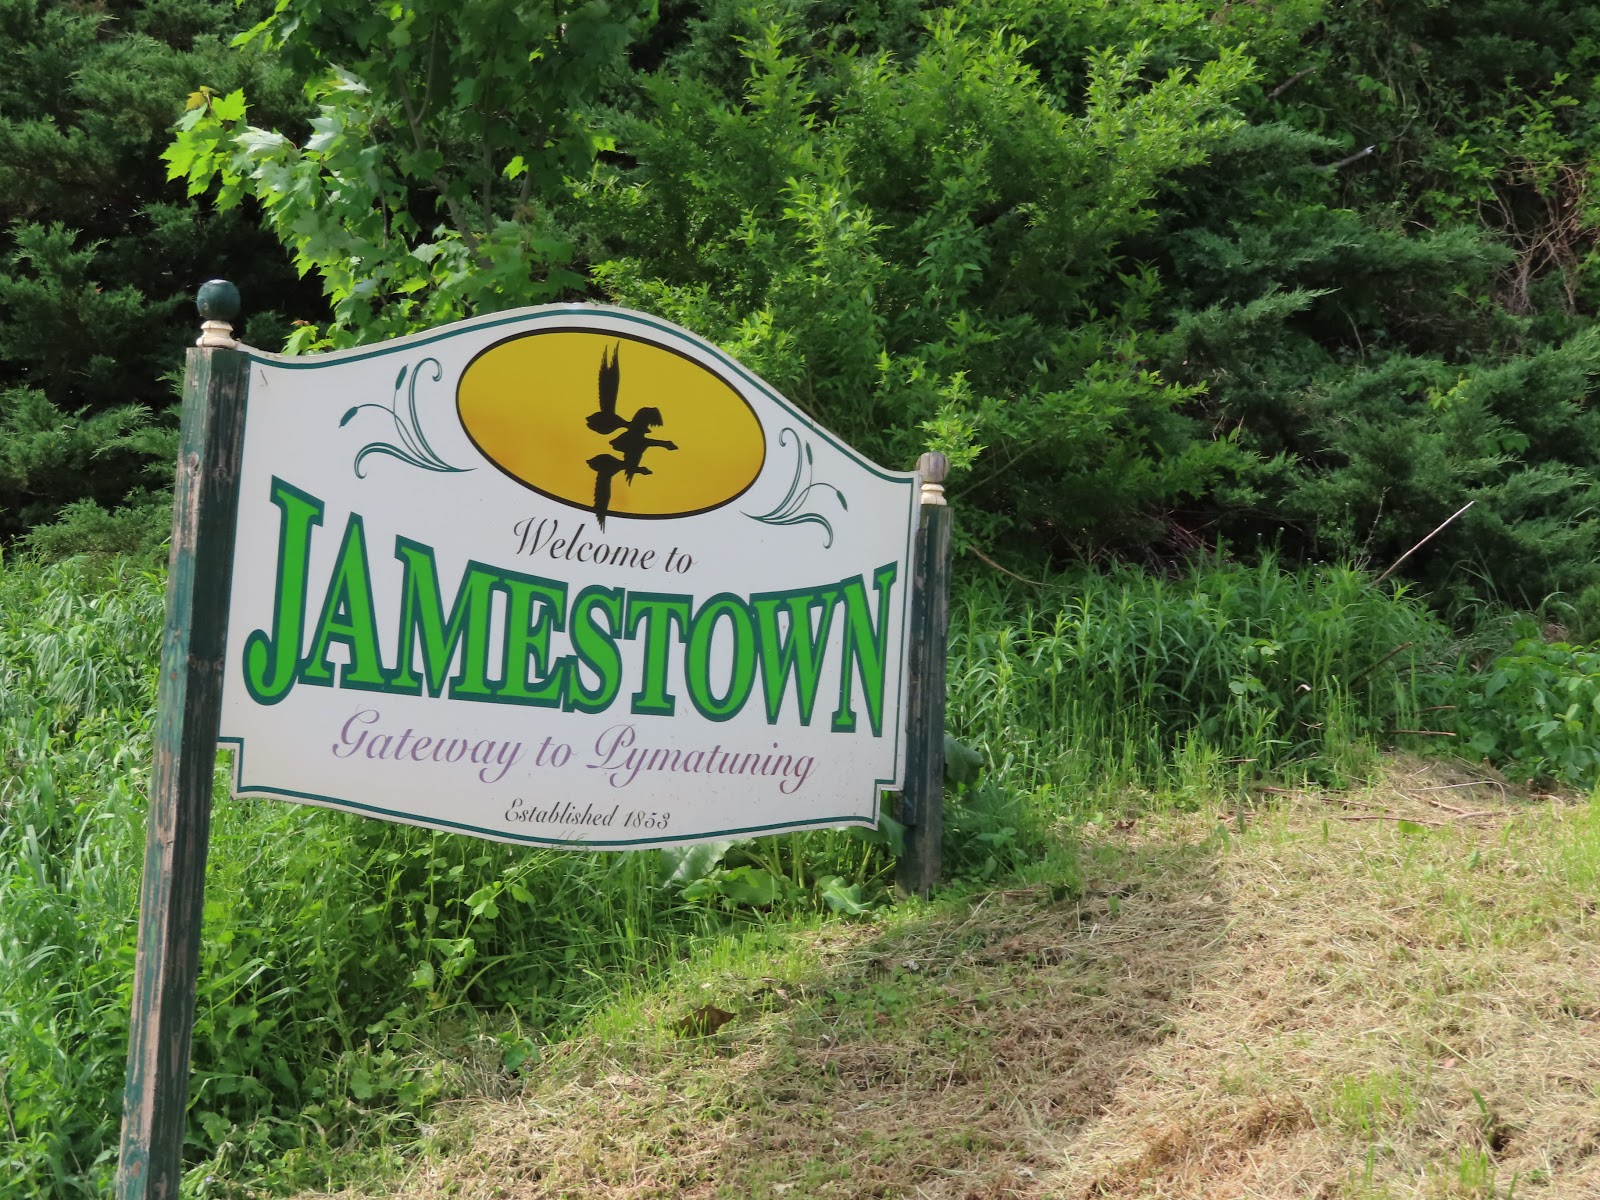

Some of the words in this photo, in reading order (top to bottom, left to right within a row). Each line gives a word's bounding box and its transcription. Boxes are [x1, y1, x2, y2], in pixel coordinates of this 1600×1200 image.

[513, 515, 656, 570] Welcome
[664, 546, 696, 575] to
[242, 474, 898, 738] JAMESTOWN
[331, 709, 524, 784] Gateway
[535, 736, 574, 768] to
[586, 723, 816, 795] Pymatuning
[504, 797, 620, 828] Established
[623, 809, 671, 830] 1853
